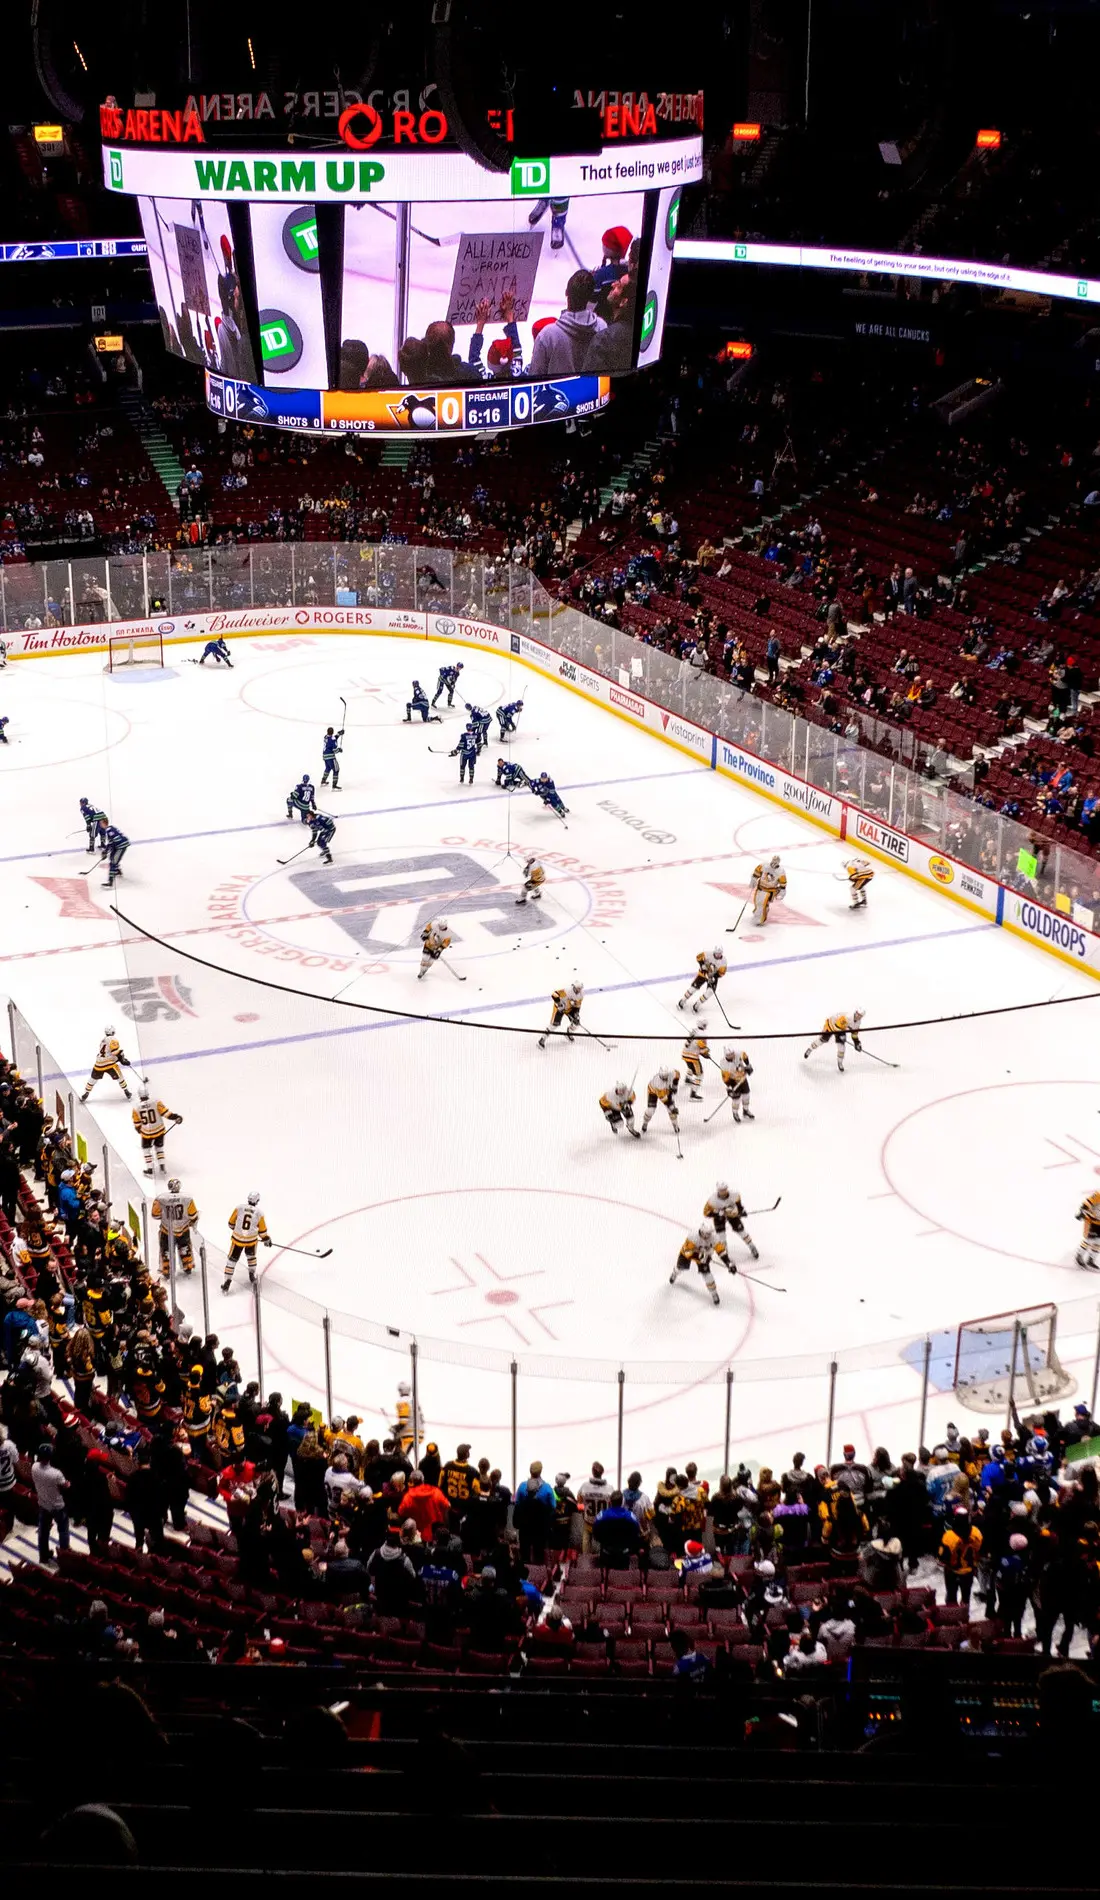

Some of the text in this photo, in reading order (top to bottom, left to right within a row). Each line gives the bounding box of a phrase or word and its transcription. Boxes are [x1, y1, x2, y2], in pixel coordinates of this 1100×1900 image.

[125, 109, 204, 142] ARENA
[194, 160, 385, 192] WARM UP
[514, 162, 546, 187] TD
[580, 164, 612, 181] That
[615, 161, 655, 178] feeling
[657, 159, 670, 174] we
[671, 157, 684, 175] get
[463, 240, 488, 260] ALL
[497, 240, 531, 259] ASKED
[479, 261, 509, 273] FROM
[830, 254, 842, 263] The
[843, 254, 866, 266] feeling
[867, 257, 873, 265] of
[874, 258, 895, 268] getting
[903, 263, 918, 271] your
[934, 264, 945, 273] but
[946, 266, 959, 275] only
[960, 269, 977, 278] using
[987, 272, 999, 281] edge
[1000, 273, 1006, 281] of
[459, 275, 518, 297] SANTA
[855, 322, 930, 342] WE ARE ALL CANUCKS
[225, 385, 235, 412] 0
[468, 391, 508, 402] PREGAME
[514, 391, 530, 420] 0
[441, 397, 460, 425] 0
[468, 408, 500, 425] 6:16
[575, 402, 595, 414] SHOTS
[277, 415, 320, 428] SHOTS 0
[330, 419, 376, 430] 0 SHOTS
[205, 613, 290, 632] Budweiser
[314, 611, 373, 625] ROGERS
[21, 632, 49, 651] Tim
[51, 630, 107, 648] Hortons
[457, 623, 499, 643] TOYOTA
[562, 660, 577, 673] PLAY
[564, 669, 577, 682] NOW
[580, 672, 600, 692] SPORTS
[670, 721, 706, 749] vistaprint
[723, 745, 775, 788] The Province
[783, 781, 833, 816] goodfood
[596, 799, 653, 833] TOYOTA
[859, 820, 906, 857] KAL TIRE
[472, 838, 627, 928] ROGERS ARENA
[207, 874, 356, 972] ROGERS ARENA
[1021, 902, 1086, 957] COLDROPS
[139, 1108, 157, 1125] 50
[241, 1214, 252, 1231] 6
